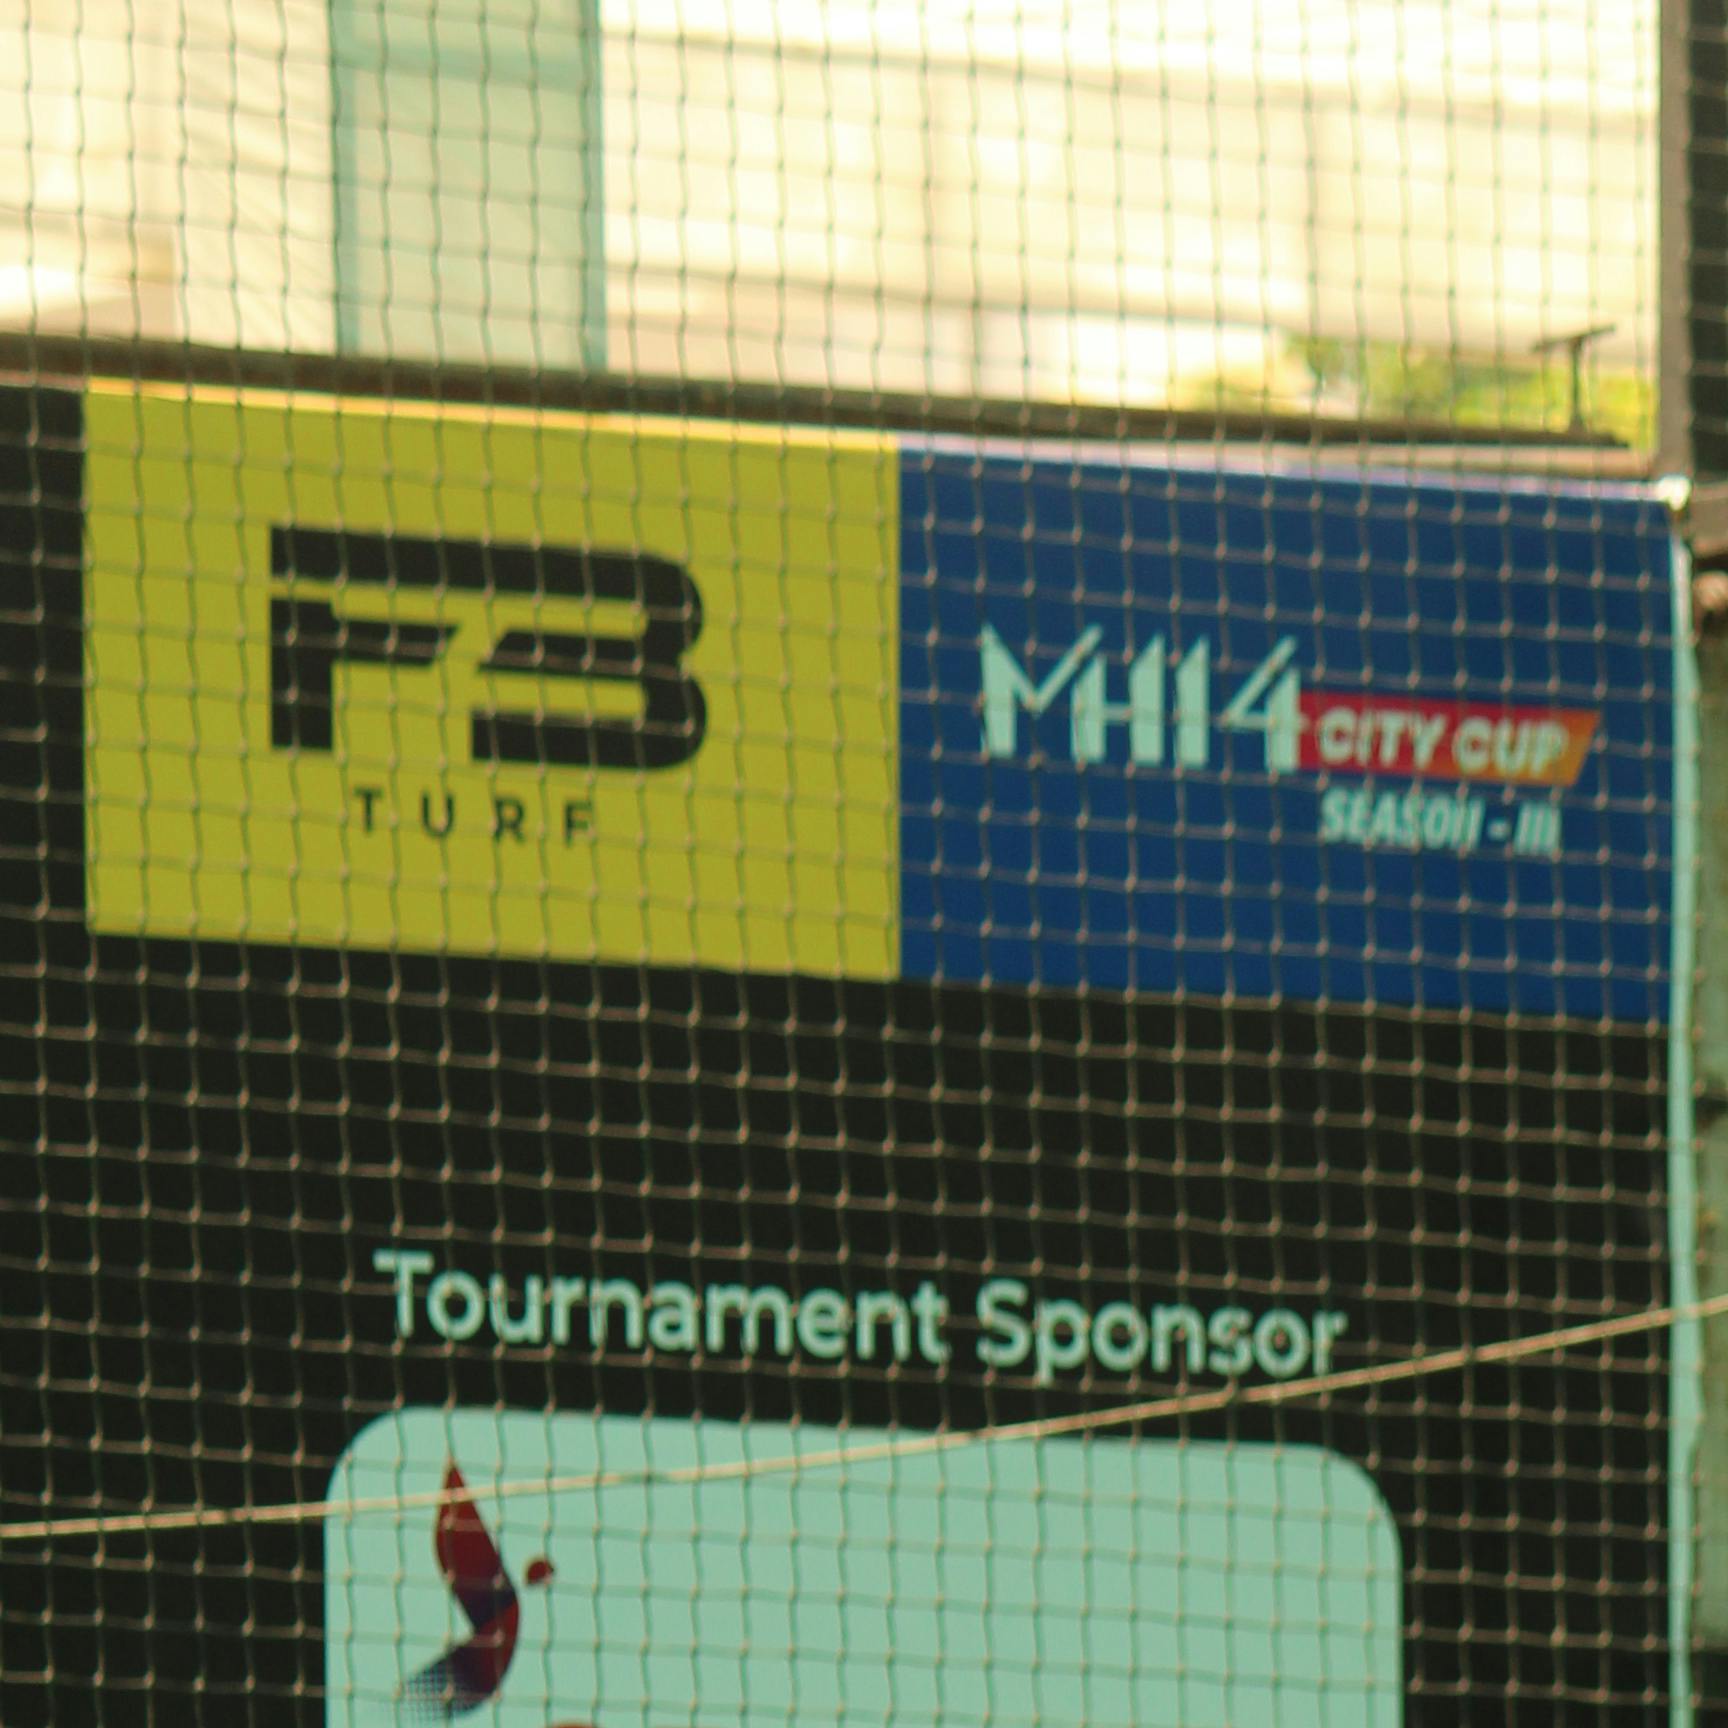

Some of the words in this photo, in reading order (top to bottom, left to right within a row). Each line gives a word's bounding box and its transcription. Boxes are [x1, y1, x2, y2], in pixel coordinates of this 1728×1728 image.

[980, 624, 1306, 773] MH14
[1318, 706, 1446, 769] CITY
[1453, 715, 1569, 778] CUP
[355, 788, 595, 846] TURF
[1321, 787, 1485, 852] SEASON
[1514, 799, 1562, 856] III
[375, 1249, 946, 1360] Tournament
[975, 1279, 1346, 1387] Sponsor
